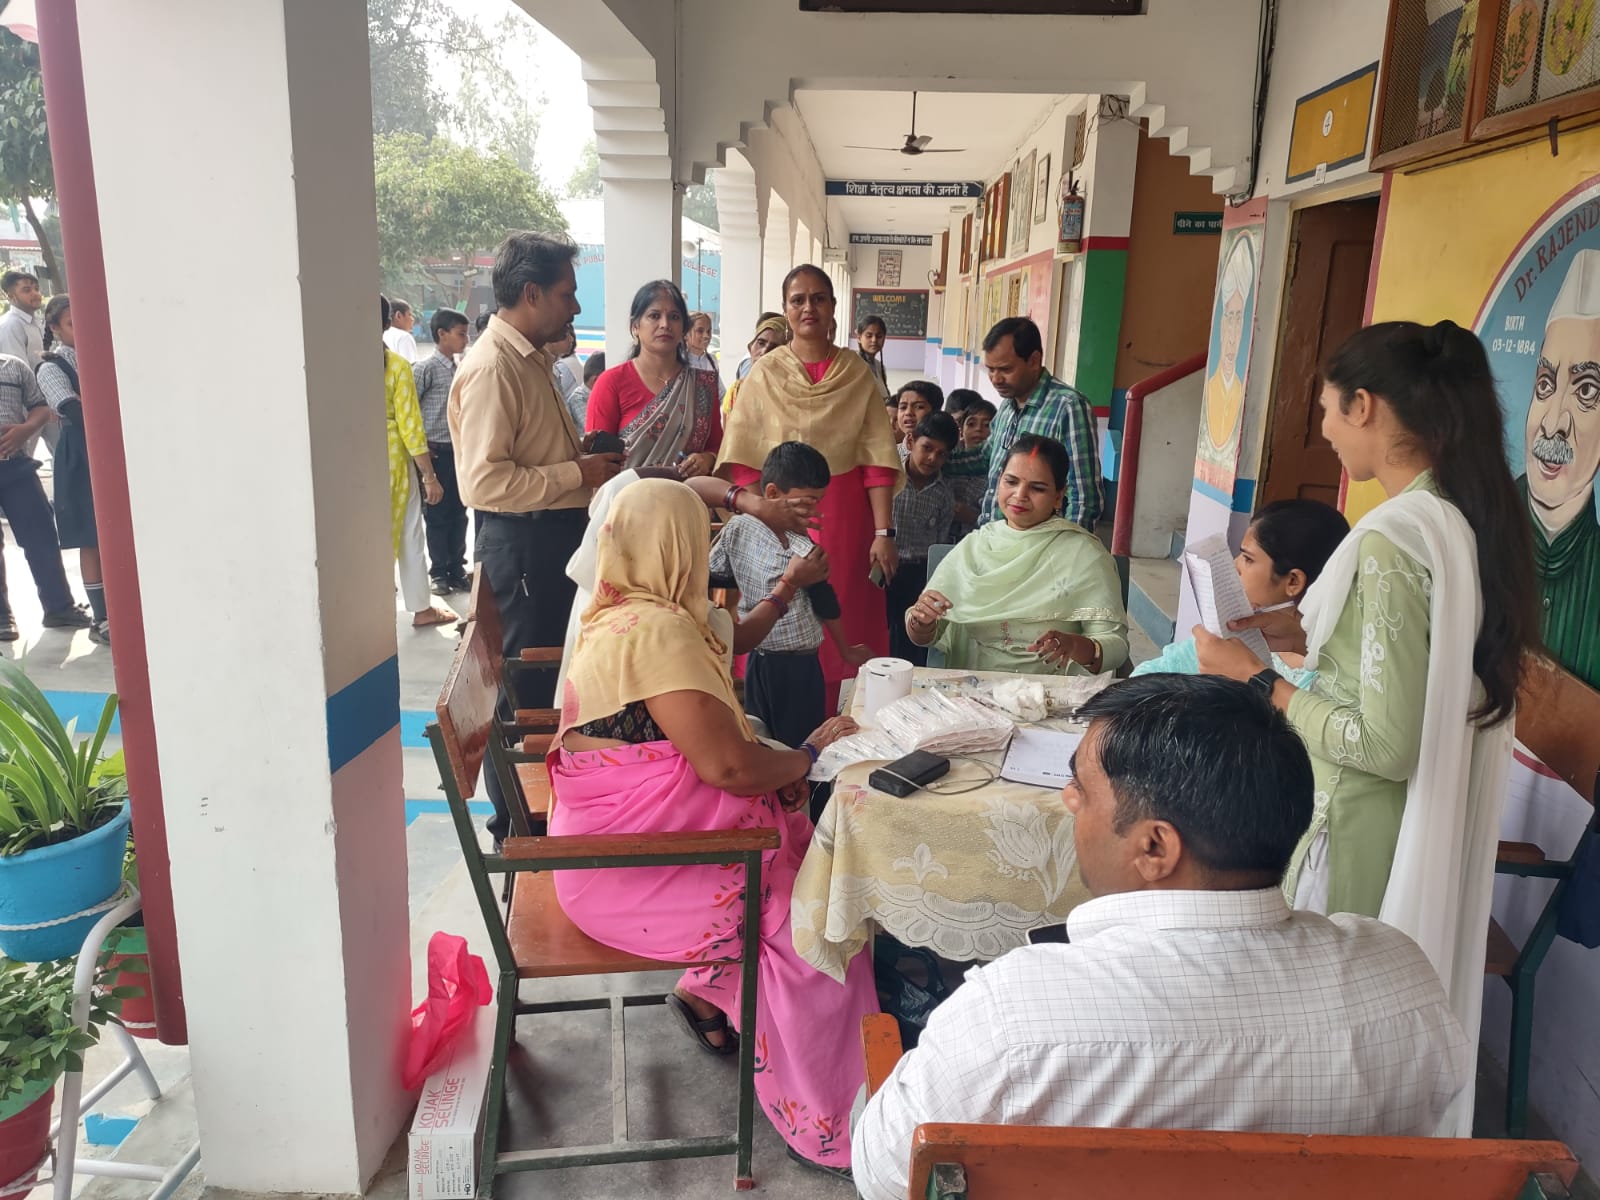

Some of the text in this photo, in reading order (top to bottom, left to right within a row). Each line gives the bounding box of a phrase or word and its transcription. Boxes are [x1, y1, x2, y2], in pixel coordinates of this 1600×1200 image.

[846, 182, 867, 195] शिक्षा
[870, 182, 895, 197] नेतृत्व
[897, 185, 921, 195] क्षमता
[923, 183, 935, 195] की
[937, 184, 961, 196] जननी
[1177, 218, 1192, 229] पीने
[1194, 220, 1206, 229] का
[1514, 268, 1538, 302] Dr.
[1504, 315, 1525, 331] BIRTH
[1492, 338, 1536, 356] 03-12-1884
[419, 1090, 441, 1129] KOJAK
[435, 1077, 460, 1129] SELINGE
[420, 1139, 430, 1175] SELINGE
